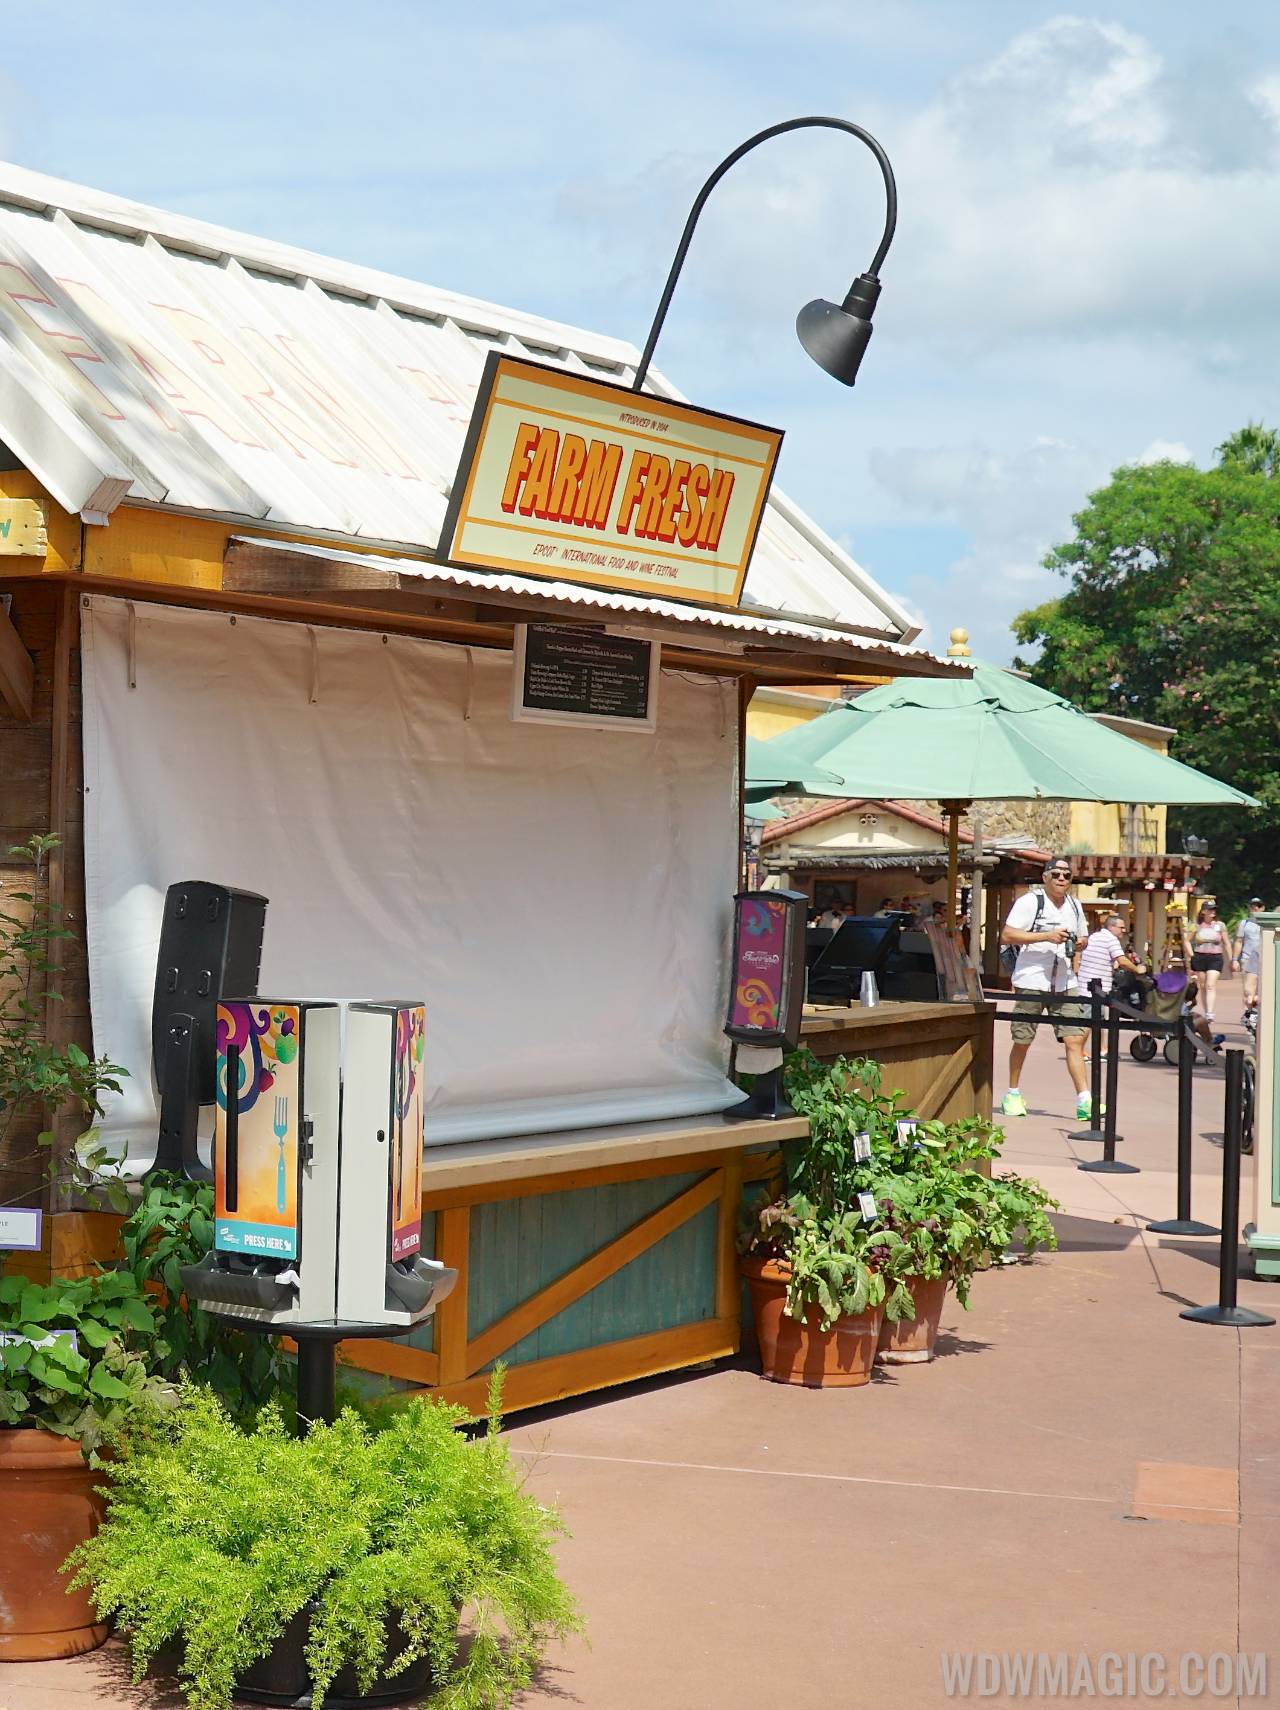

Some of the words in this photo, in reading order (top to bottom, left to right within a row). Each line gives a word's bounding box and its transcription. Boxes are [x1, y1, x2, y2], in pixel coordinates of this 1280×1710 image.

[619, 412, 651, 428] INTRODUCED
[500, 422, 624, 531] FARM
[616, 449, 736, 552] FRESH
[561, 548, 608, 567] INTERNATIONAL
[608, 556, 625, 570] FOOD
[625, 559, 640, 572] AND
[639, 562, 655, 575] WINE
[654, 564, 680, 579] FESTIVAL
[244, 1234, 266, 1248] PRESS
[266, 1237, 284, 1250] HERE
